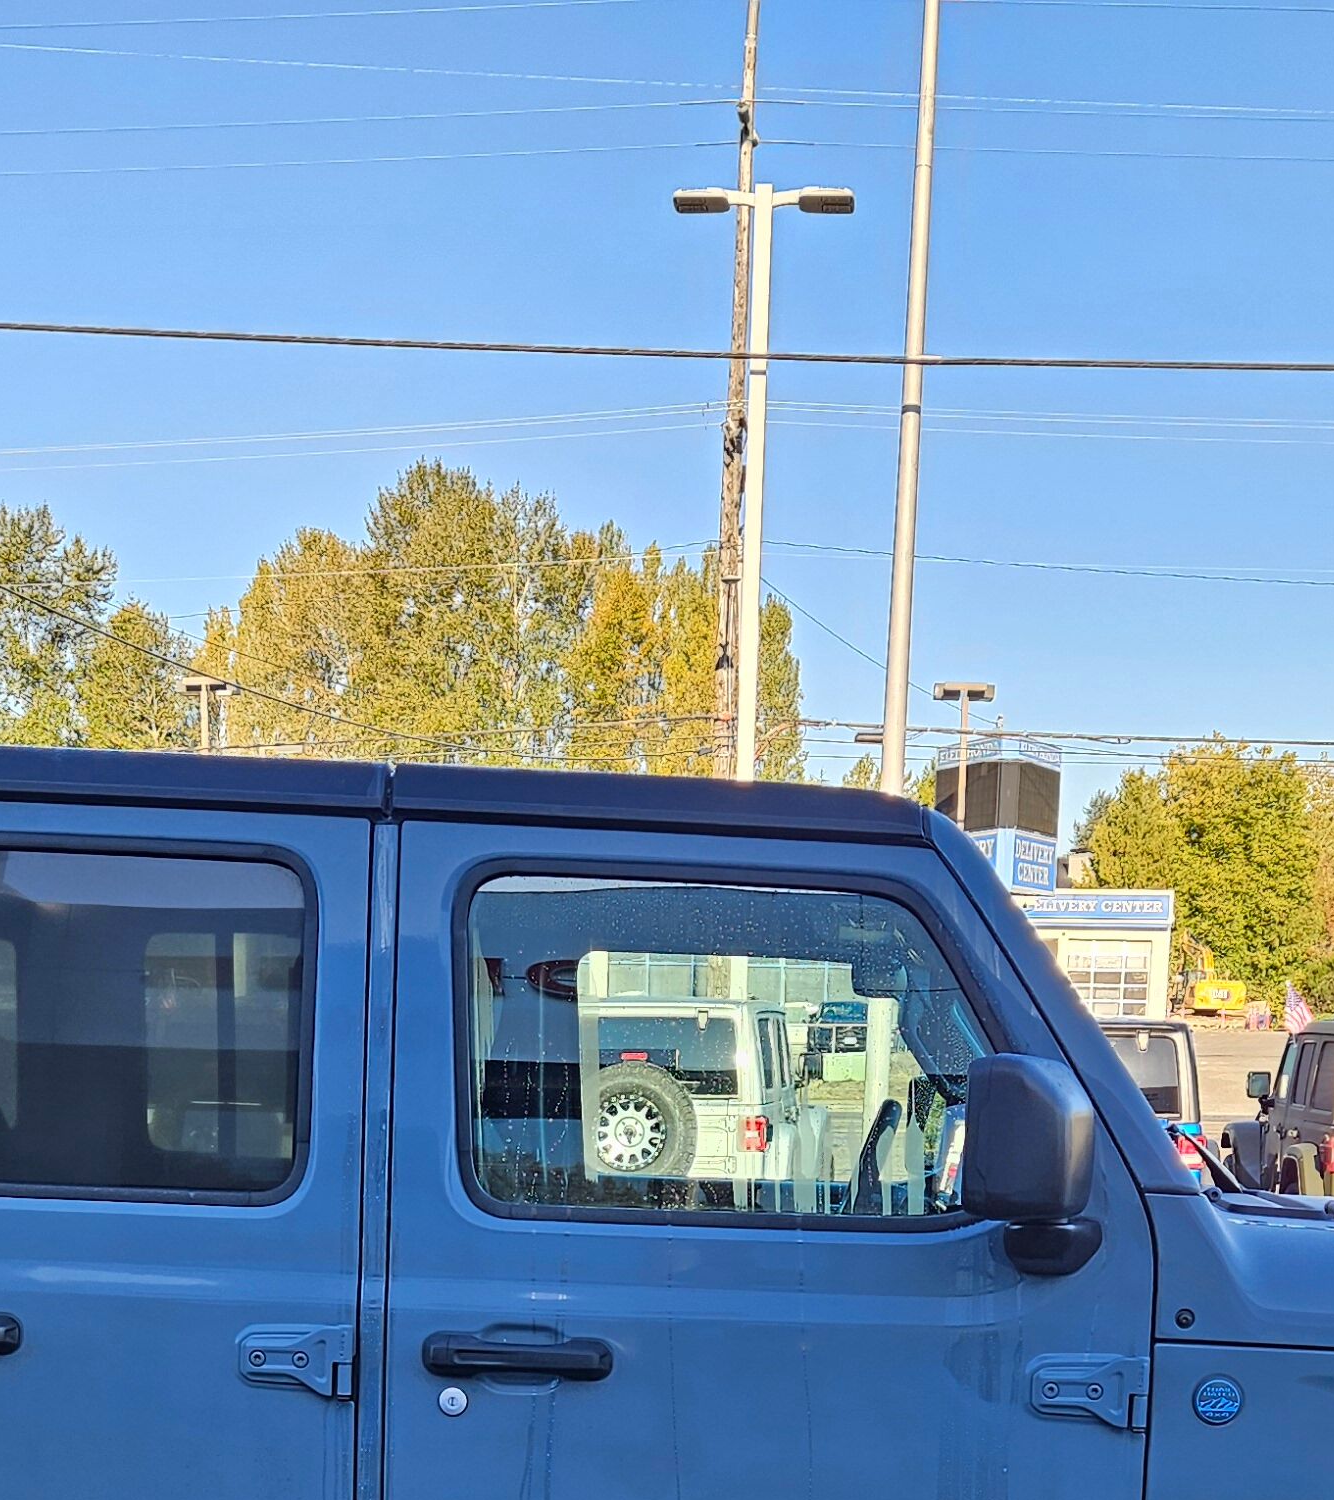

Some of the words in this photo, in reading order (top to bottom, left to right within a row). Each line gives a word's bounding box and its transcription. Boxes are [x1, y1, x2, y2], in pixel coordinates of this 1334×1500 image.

[1016, 840, 1054, 864] DELIVERY
[1017, 862, 1050, 886] CENTER
[1100, 900, 1163, 913] CENTER
